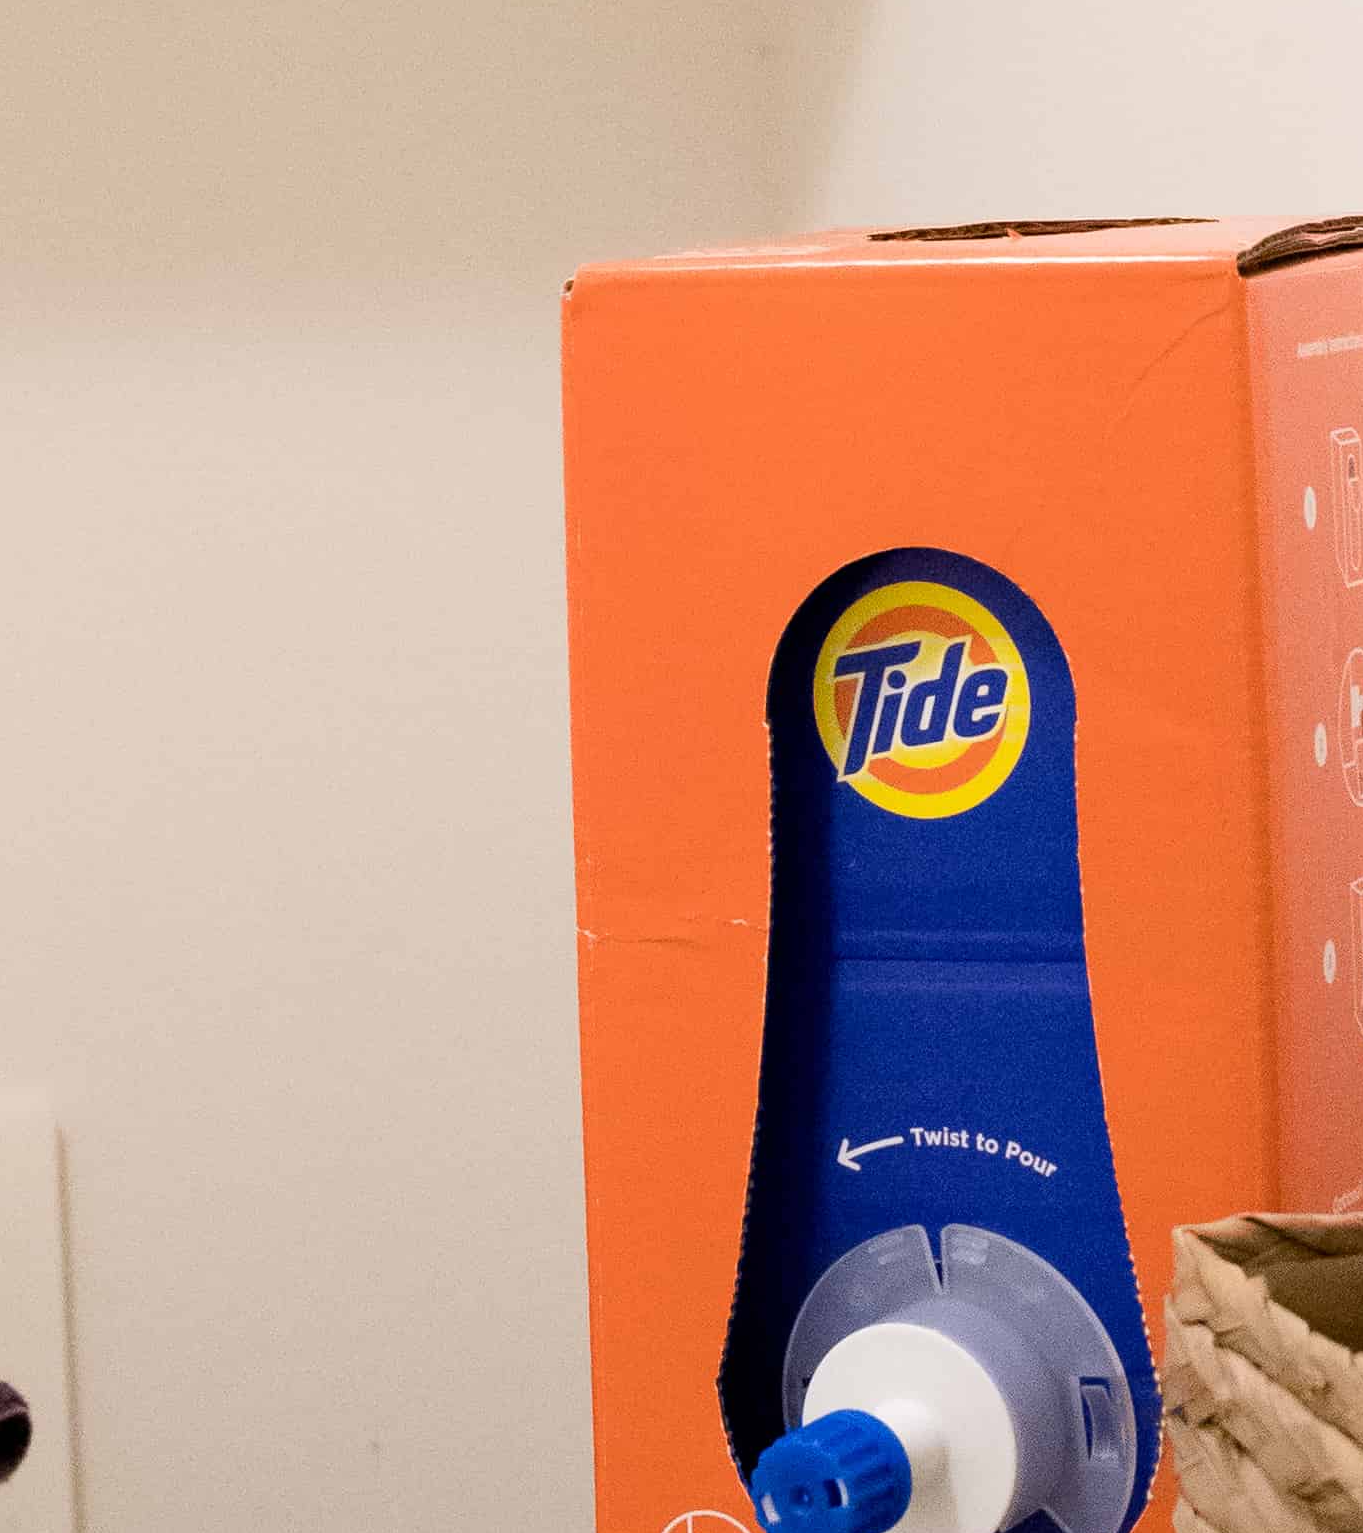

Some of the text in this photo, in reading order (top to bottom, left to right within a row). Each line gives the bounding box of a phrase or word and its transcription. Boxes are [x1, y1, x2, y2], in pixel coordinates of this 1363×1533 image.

[833, 639, 1009, 777] Tide
[909, 1126, 1058, 1177] Twist to Pour
